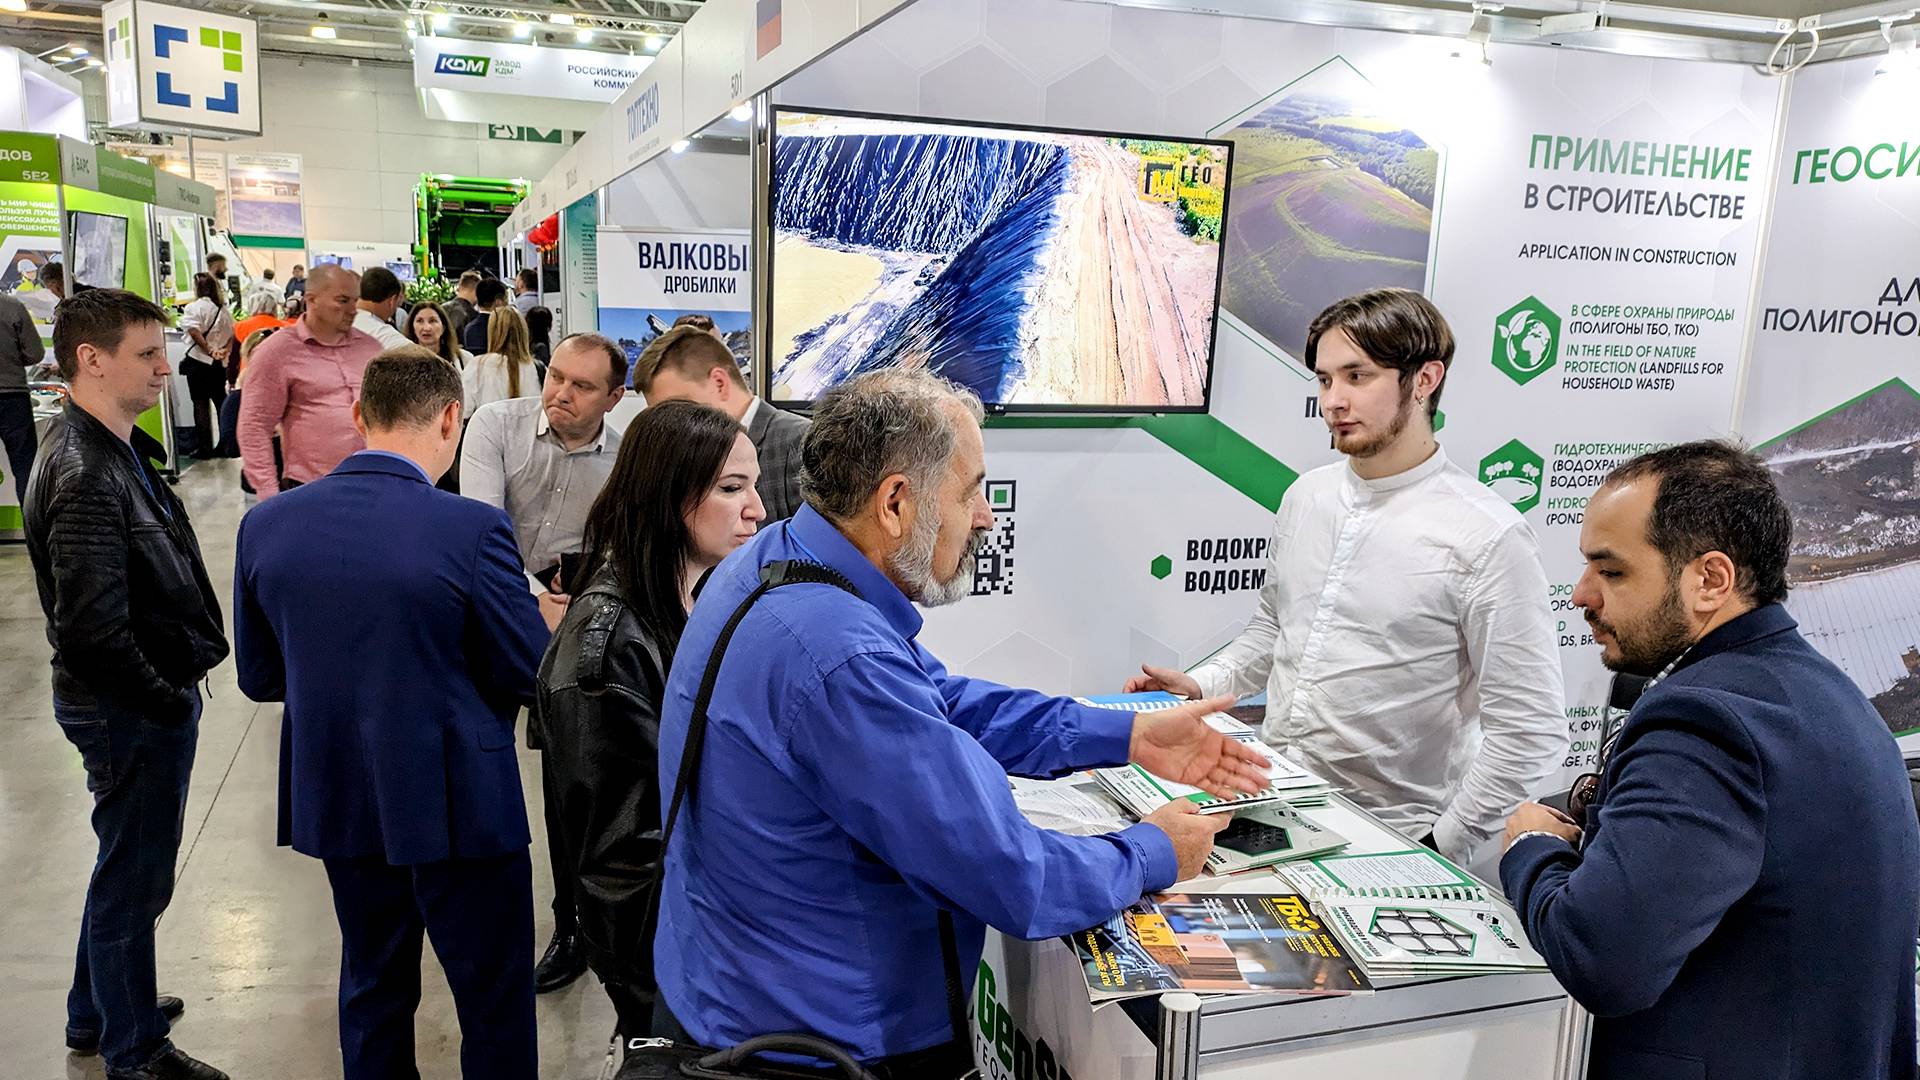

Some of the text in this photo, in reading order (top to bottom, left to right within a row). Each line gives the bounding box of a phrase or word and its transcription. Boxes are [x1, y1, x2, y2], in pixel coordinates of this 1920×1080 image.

[494, 60, 521, 69] ЗАВОД
[1529, 134, 1752, 182] ПРИМЕНЕНИЕ
[22, 170, 49, 181] 5E2
[1524, 183, 1745, 220] В СТРОИТЕЛЬСТВЕ
[638, 242, 751, 272] ВАЛКОВЫ
[1518, 243, 1737, 266] APPLICATION IN CONSTRUCTION
[664, 275, 736, 295] ДРОБИЛКИ
[1571, 305, 1735, 322] В СФЕРЕ ОХРАНЫ ПРИРОДЫ
[1569, 321, 1699, 337] (ПОЛИГОНЫ ТБО, ТКО)
[1763, 308, 1920, 337] ПОЛИГОНО
[1566, 344, 1696, 358] IN THE FIELD OF NATURE
[1564, 361, 1723, 375] PROTECTION (LANDFILLS FOR
[1562, 377, 1674, 391] HOUSEHOLD WASTE)
[1548, 498, 1590, 509] HYDRO
[1569, 740, 1599, 753] OUN
[1562, 755, 1583, 767] GE,
[978, 959, 1073, 1080] GeoS
